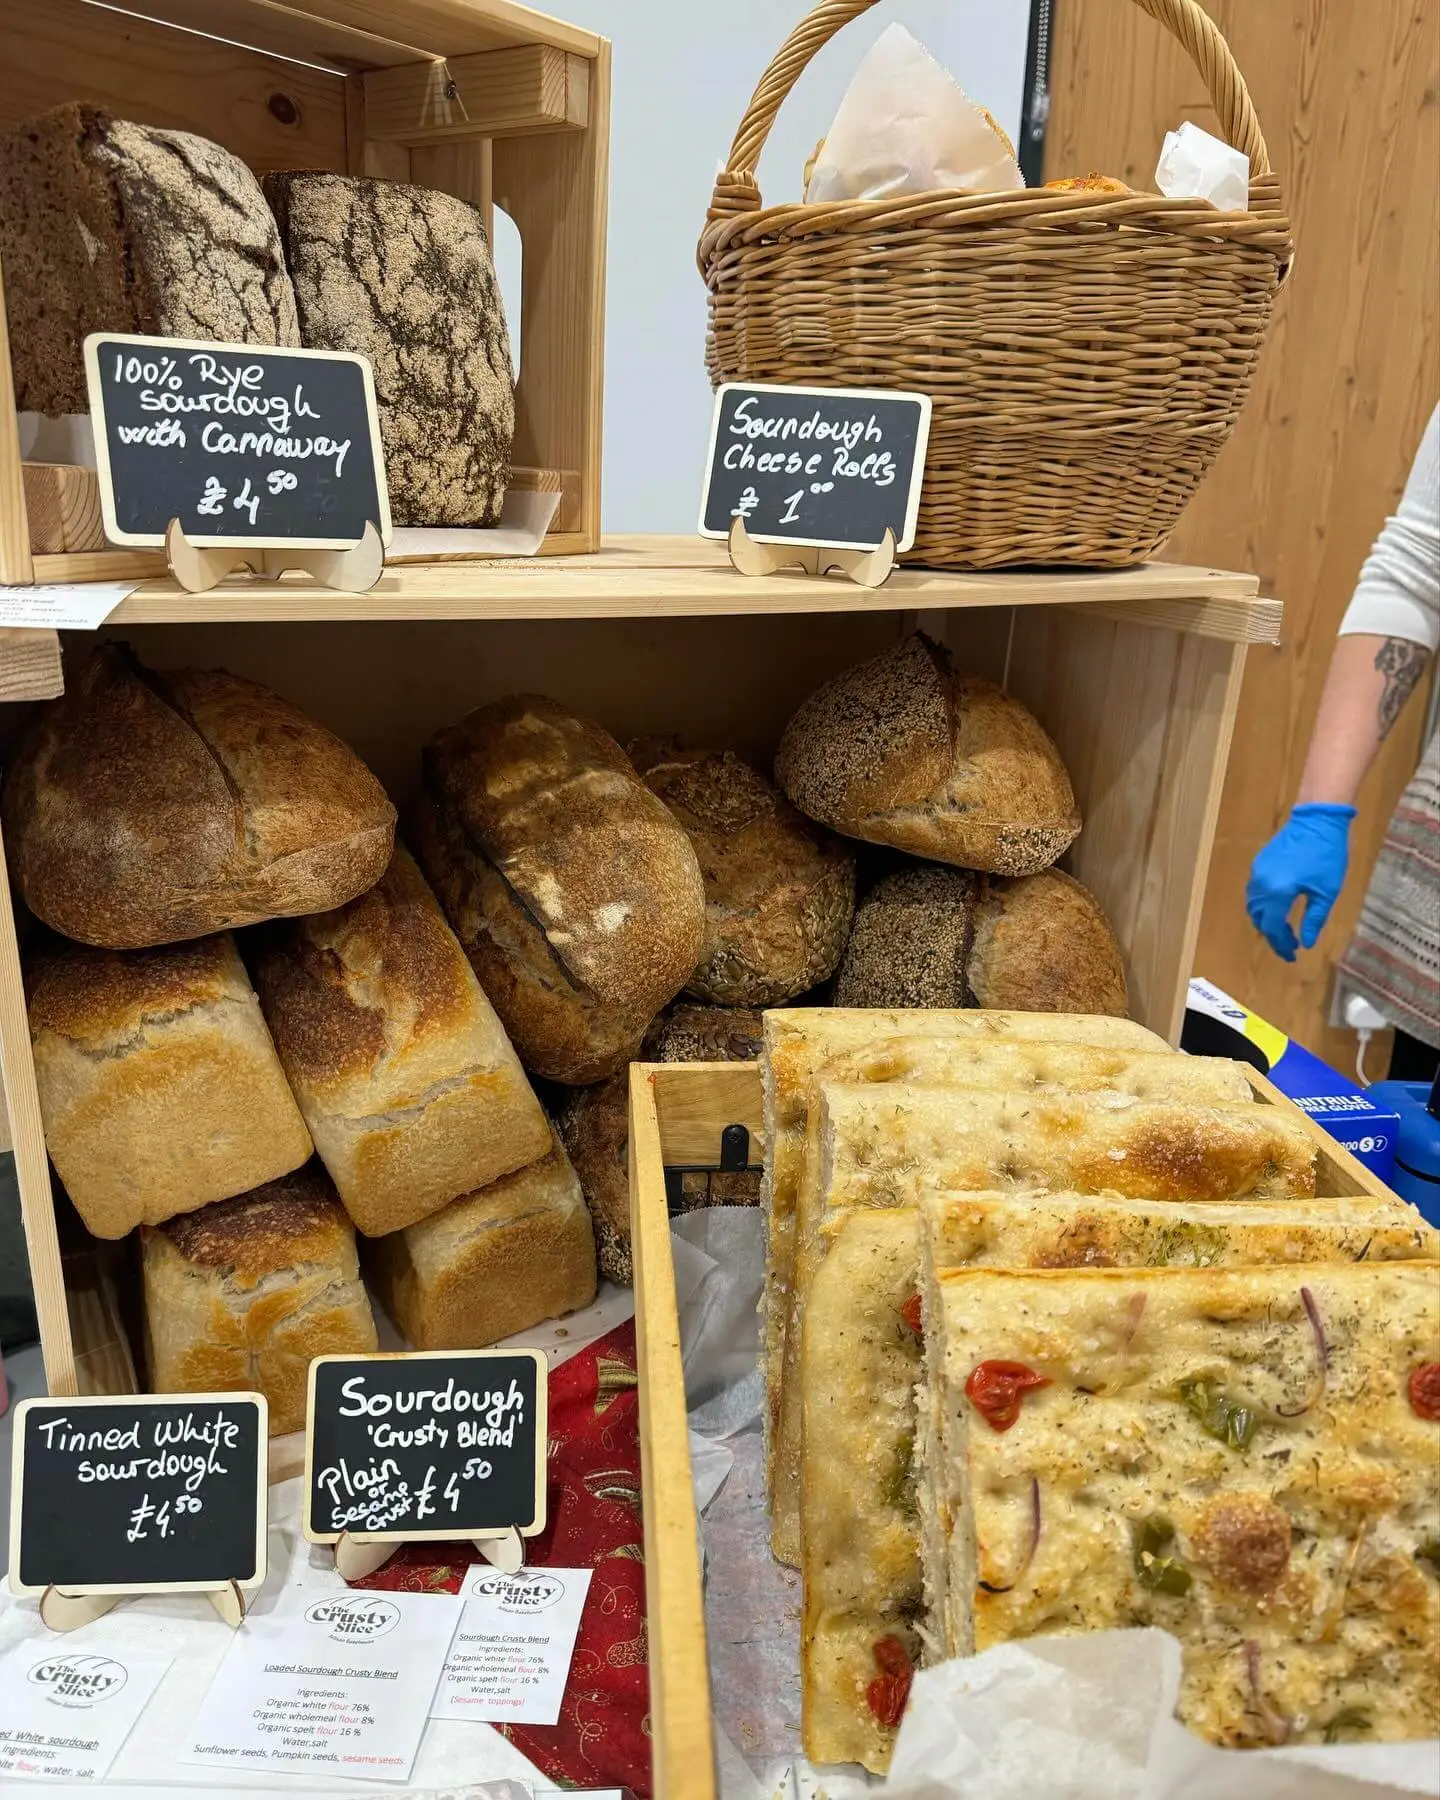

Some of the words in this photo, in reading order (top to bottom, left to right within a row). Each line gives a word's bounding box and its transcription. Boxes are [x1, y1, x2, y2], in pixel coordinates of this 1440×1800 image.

[114, 355, 182, 390] 100%
[189, 354, 264, 392] Rye
[729, 397, 883, 449] Sourdough
[118, 418, 186, 448] with
[723, 443, 822, 474] Cheese
[832, 446, 897, 486] Rolls
[1292, 1095, 1368, 1106] NITRILE
[1329, 1103, 1376, 1111] GLOVES
[339, 1376, 524, 1428] Sourdough
[39, 1418, 140, 1452] Tinned
[154, 1410, 240, 1448] White
[318, 1458, 401, 1505] Plain
[368, 1482, 389, 1498] or
[480, 1583, 556, 1600] Crusty
[502, 1595, 540, 1605] Slice
[312, 1608, 392, 1628] Crusty
[334, 1623, 374, 1633] Slice
[459, 1633, 500, 1641] Sourdough
[502, 1635, 526, 1643] Crusty
[527, 1636, 550, 1644] Blend
[453, 1654, 482, 1662] Organic
[57, 1665, 76, 1673] The
[264, 1664, 295, 1672] Loaded
[297, 1665, 343, 1676] Sourdough
[345, 1668, 371, 1677] Crusty
[374, 1670, 399, 1679] Blend
[442, 1664, 472, 1672] Organic
[474, 1665, 516, 1673] wholemeal
[36, 1666, 118, 1692] Crusty
[447, 1674, 477, 1683] Organic
[53, 1684, 95, 1697] Slice
[297, 1689, 348, 1699] Ingredients:
[266, 1699, 300, 1708] Organic
[302, 1701, 327, 1710] white
[328, 1702, 349, 1711] flour
[351, 1704, 370, 1712] 76%
[253, 1710, 287, 1720] Organic
[289, 1712, 336, 1722] wholemeal
[338, 1715, 360, 1723] flour
[361, 1717, 375, 1725] 8%
[257, 1723, 291, 1733] Organic
[292, 1725, 315, 1734] spelt
[317, 1726, 338, 1735] flour
[16, 1731, 44, 1742] White
[48, 1735, 99, 1749] sourdough
[193, 1744, 239, 1756] Sunflower
[271, 1749, 310, 1761] Pumpkin
[311, 1751, 340, 1762] seeds,
[342, 1755, 376, 1764] sesame
